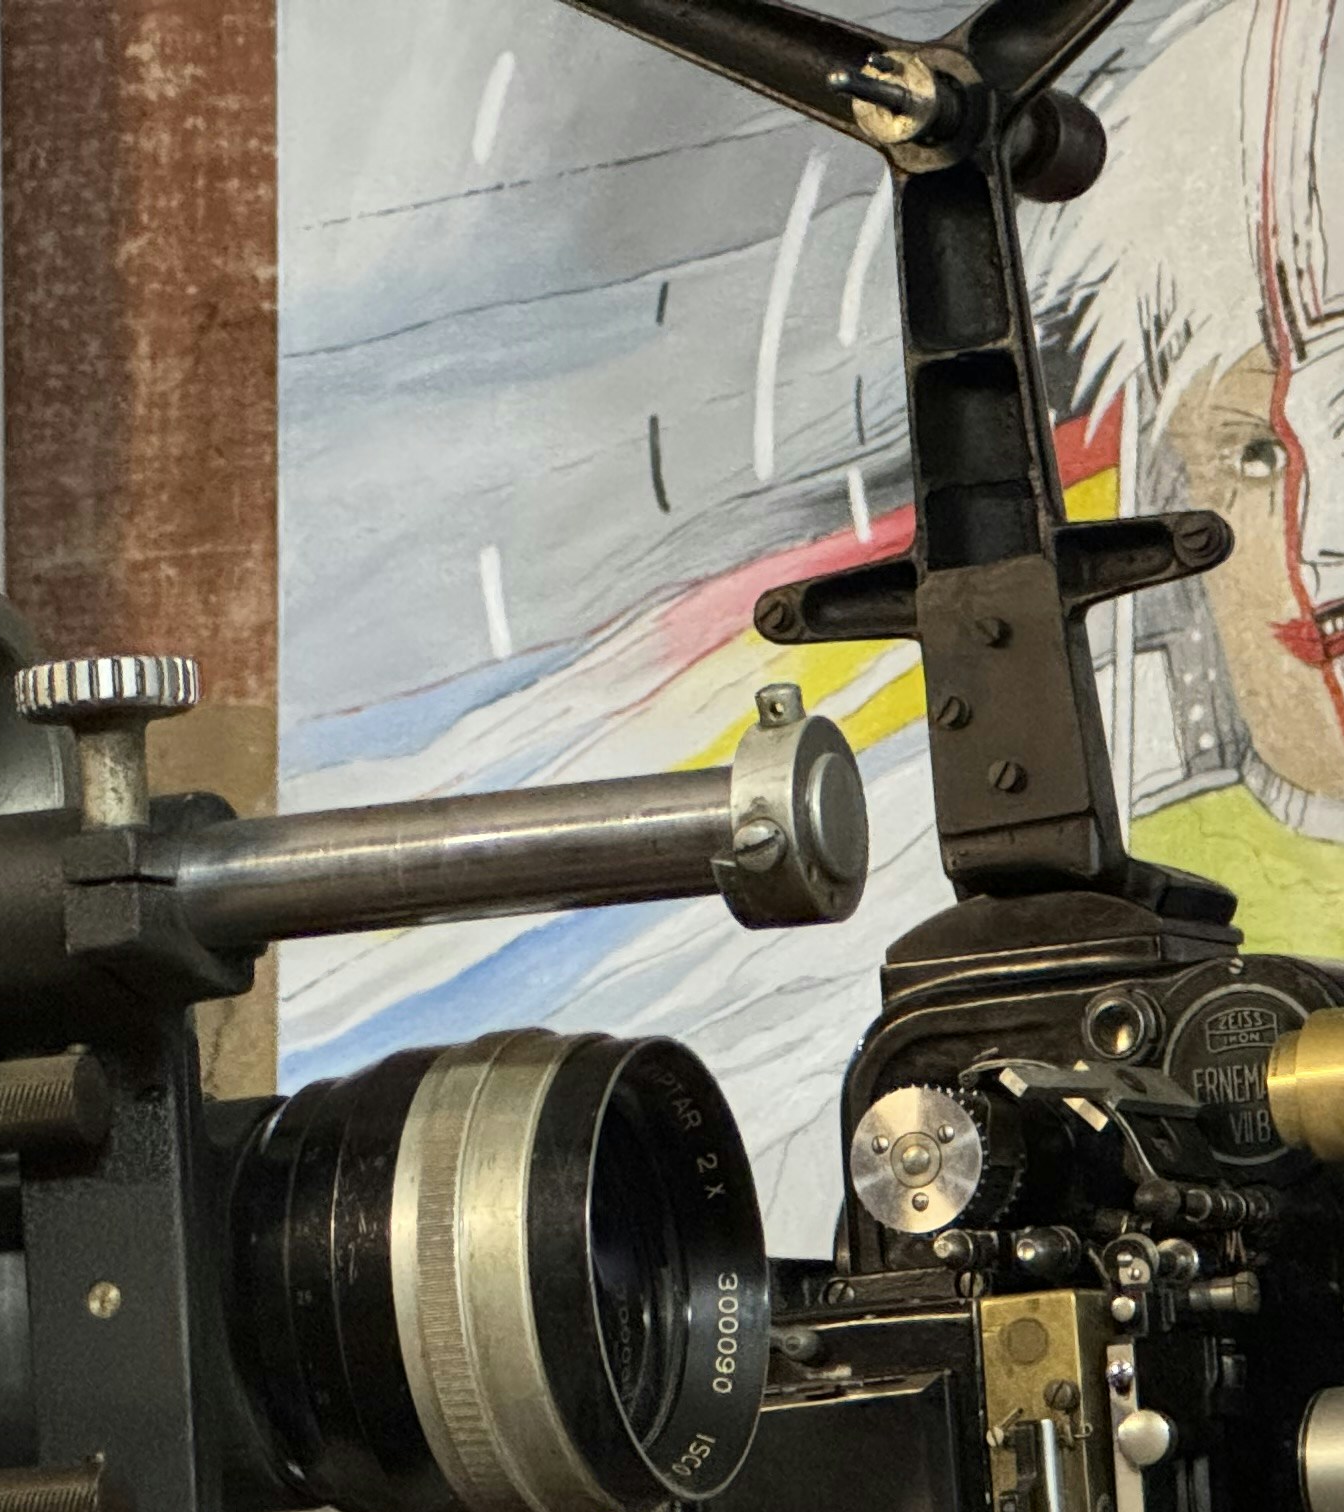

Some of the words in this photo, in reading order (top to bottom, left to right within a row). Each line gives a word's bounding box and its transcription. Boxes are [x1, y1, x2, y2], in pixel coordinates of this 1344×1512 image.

[1217, 1010, 1263, 1030] ZEISS
[1223, 1031, 1261, 1045] IKON
[696, 1152, 718, 1174] 2
[712, 1271, 739, 1394] 300090
[672, 1433, 717, 1477] ISCO
